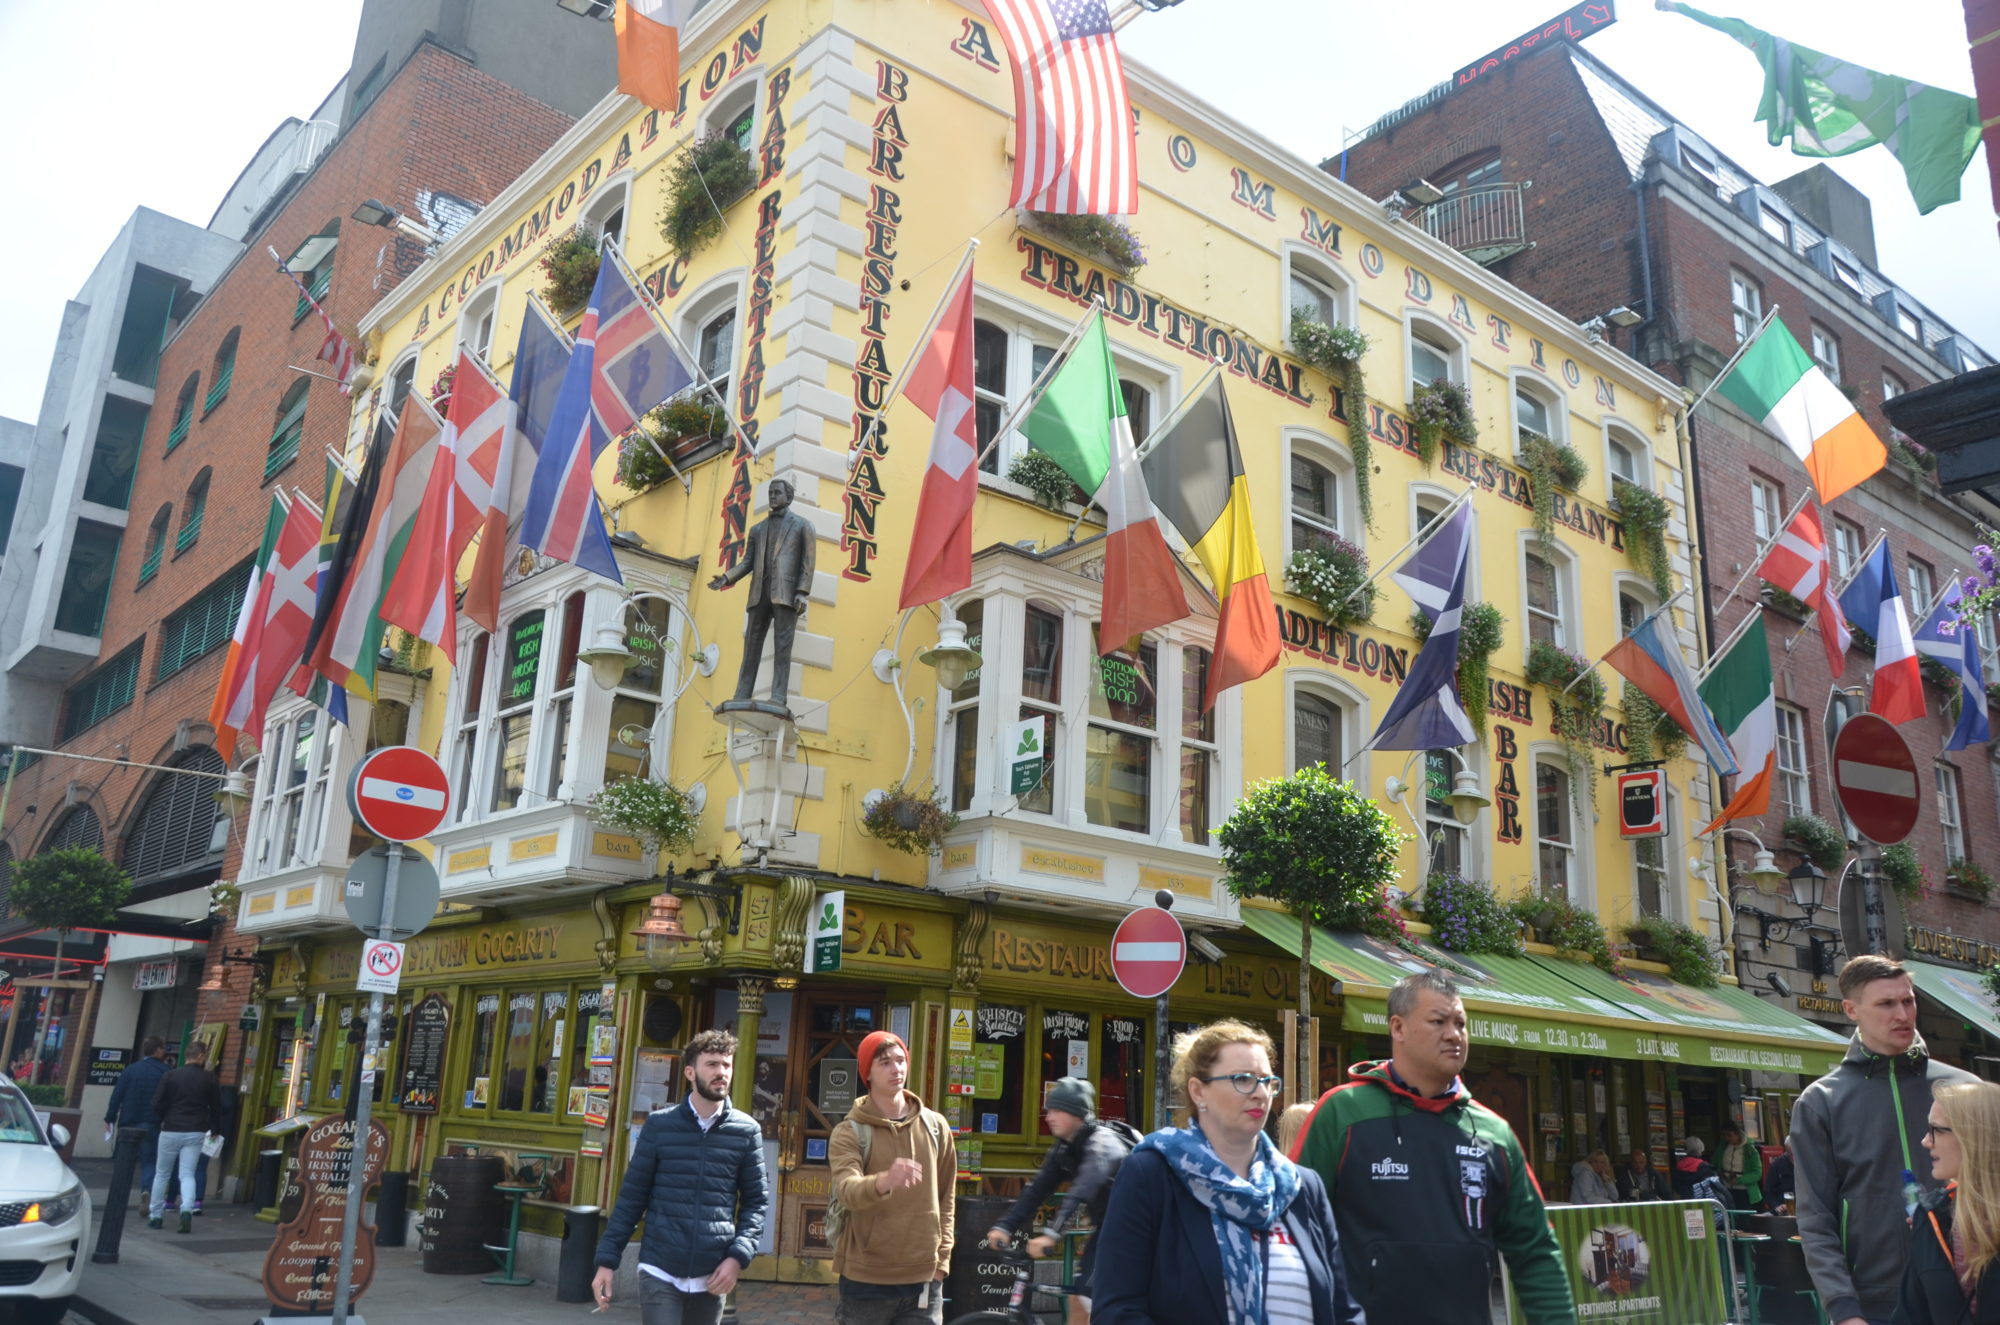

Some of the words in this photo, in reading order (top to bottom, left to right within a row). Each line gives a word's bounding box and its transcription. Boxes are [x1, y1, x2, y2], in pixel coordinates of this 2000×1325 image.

[759, 66, 793, 188] BAR
[873, 59, 909, 181] BAR
[950, 16, 1617, 412] AOMMODATION
[841, 183, 904, 583] RESTAURANT
[1017, 235, 1314, 409] TRADITIONAL
[1441, 439, 1626, 553] RESTARANT
[1494, 723, 1523, 846] BAR
[475, 923, 566, 966] GOGARTY
[839, 905, 923, 960] BAR
[977, 1007, 1026, 1026] WHISKEY
[1043, 1015, 1063, 1030] IRISH
[1112, 1020, 1134, 1033] FOOD
[1470, 1019, 1490, 1038] LIVE
[1491, 1023, 1518, 1043] MUSIC
[1545, 1028, 1568, 1047] 12.30
[1643, 1039, 1660, 1056] LATE
[1661, 1041, 1680, 1058] BARS
[1710, 1046, 1750, 1064] RESTAURANT
[1760, 1051, 1784, 1067] SECOND
[1784, 1053, 1803, 1069] FLOOR
[92, 1062, 126, 1070] CAUTION
[311, 1120, 386, 1149] GOGARY'S
[308, 1160, 338, 1171] IRISH
[309, 1149, 380, 1162] TRADITIAL
[1371, 1157, 1409, 1176] FUJITSU
[1578, 1300, 1618, 1316] PENTHOUSE
[1618, 1295, 1661, 1312] APARTMENTS
